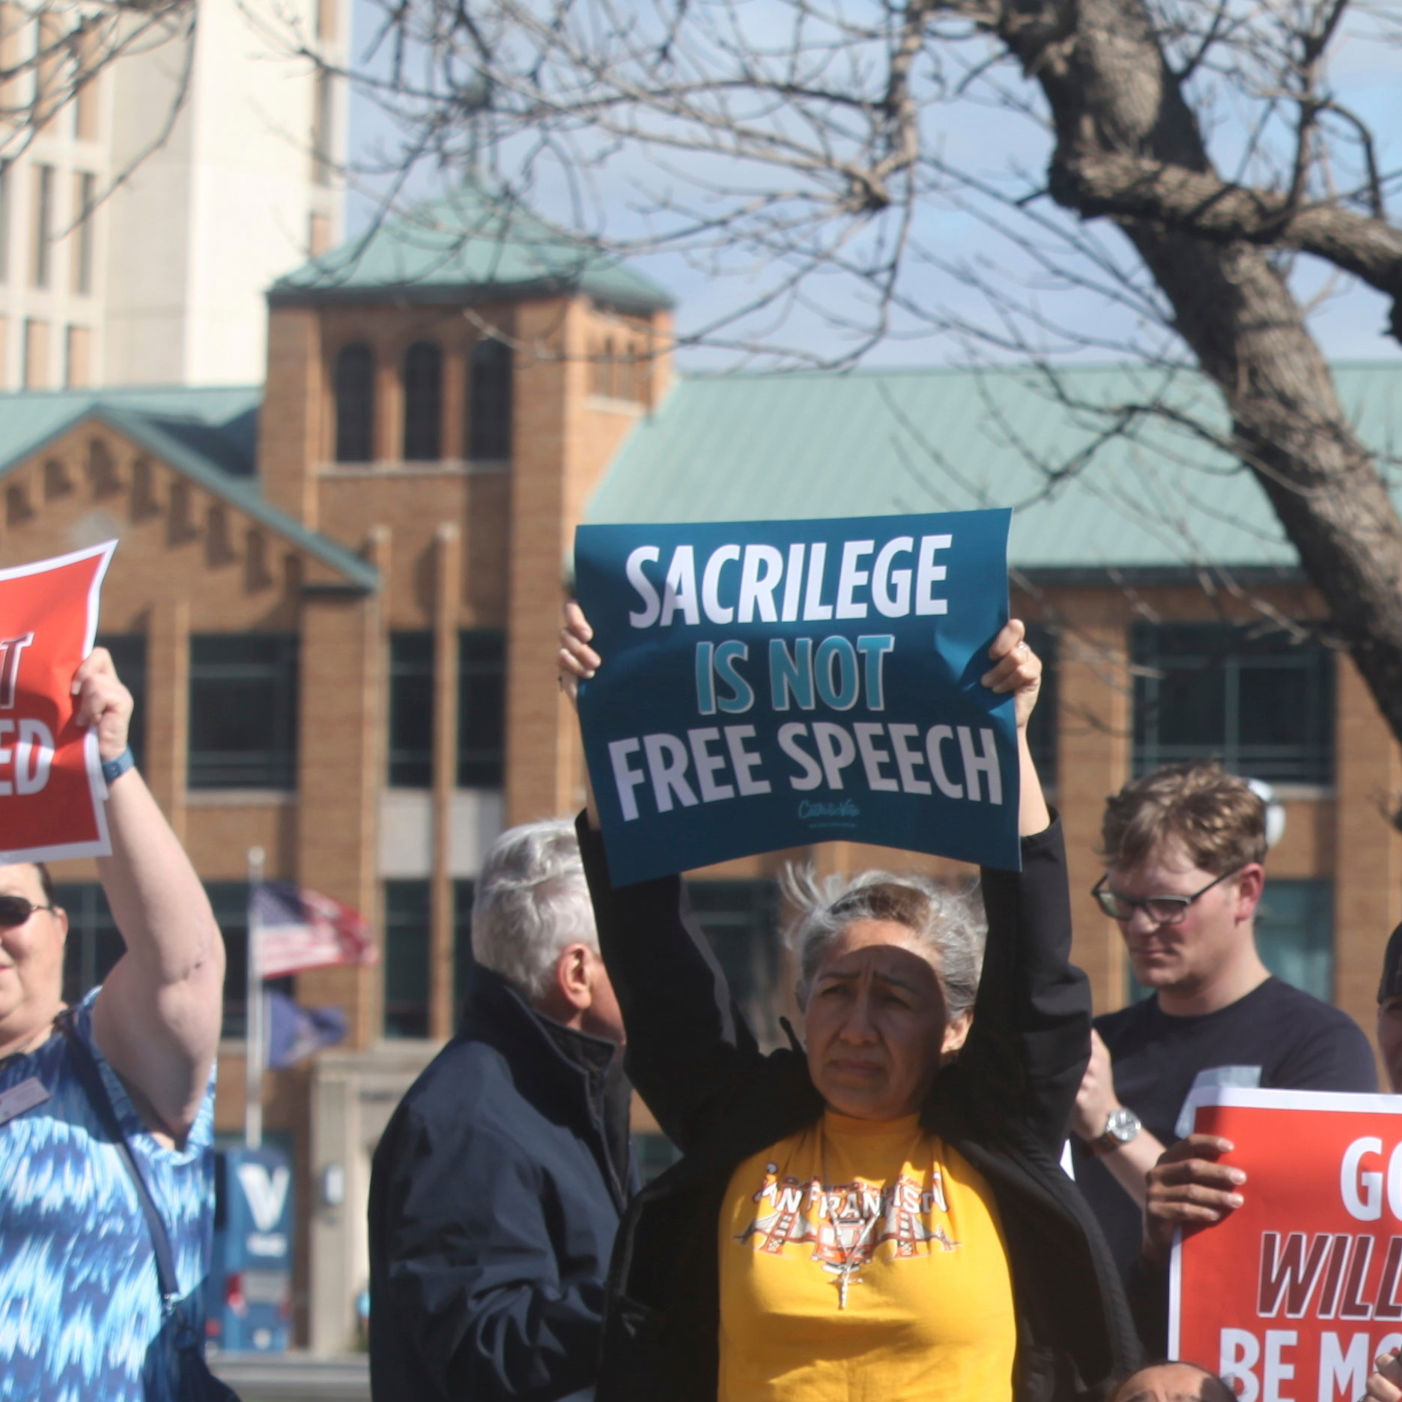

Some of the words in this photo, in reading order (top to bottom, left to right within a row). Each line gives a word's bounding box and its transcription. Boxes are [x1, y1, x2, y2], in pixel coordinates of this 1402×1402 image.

[624, 533, 954, 630] SACRILEGE
[695, 638, 756, 716] IS
[768, 633, 896, 713] NOT
[607, 724, 772, 822] FREE
[777, 721, 1004, 806] SPEECH
